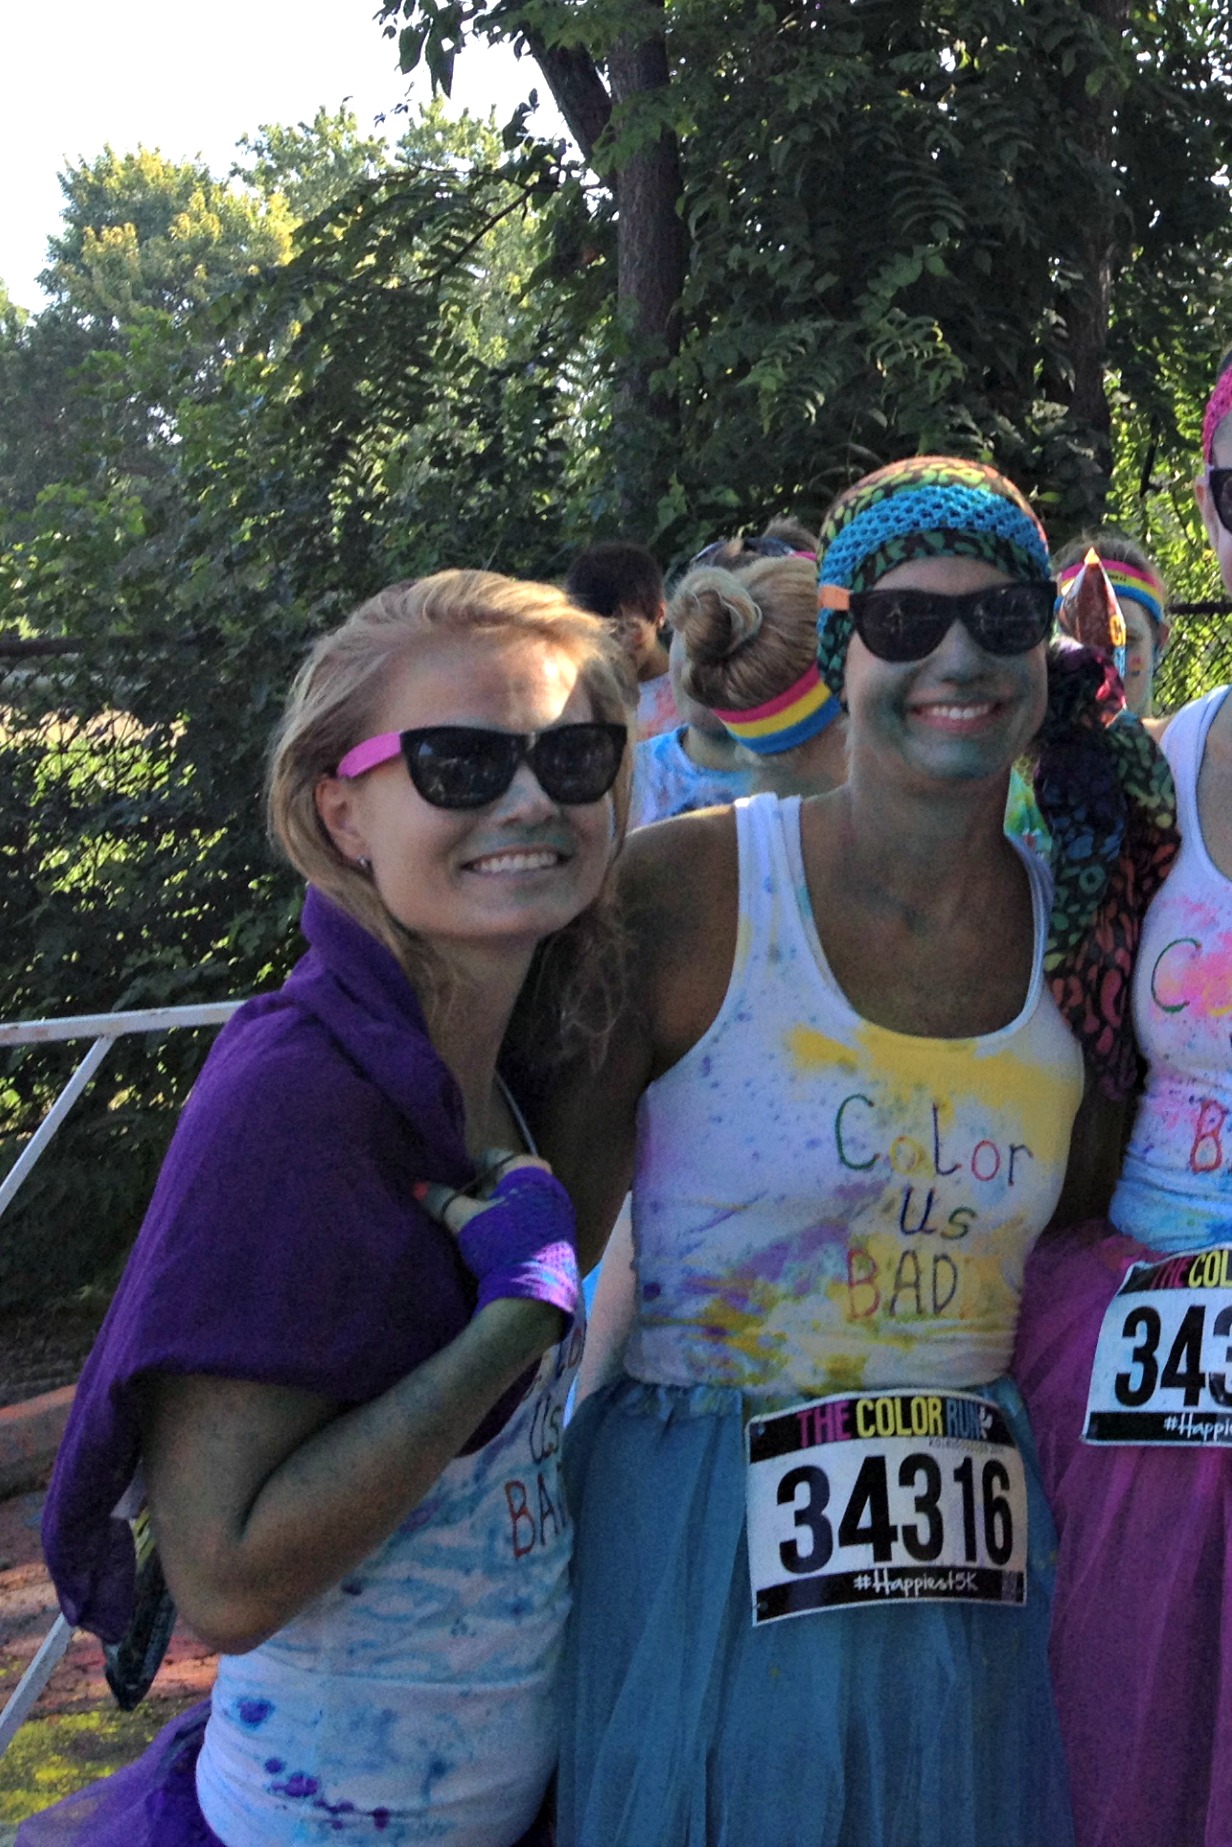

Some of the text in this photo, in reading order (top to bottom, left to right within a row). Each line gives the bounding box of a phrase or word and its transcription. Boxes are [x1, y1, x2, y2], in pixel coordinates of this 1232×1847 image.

[1150, 1259, 1190, 1290] THE
[797, 1397, 982, 1449] THE COLOR RUN
[777, 1454, 1013, 1574] 34316
[853, 1568, 978, 1597] #Happiest5K
